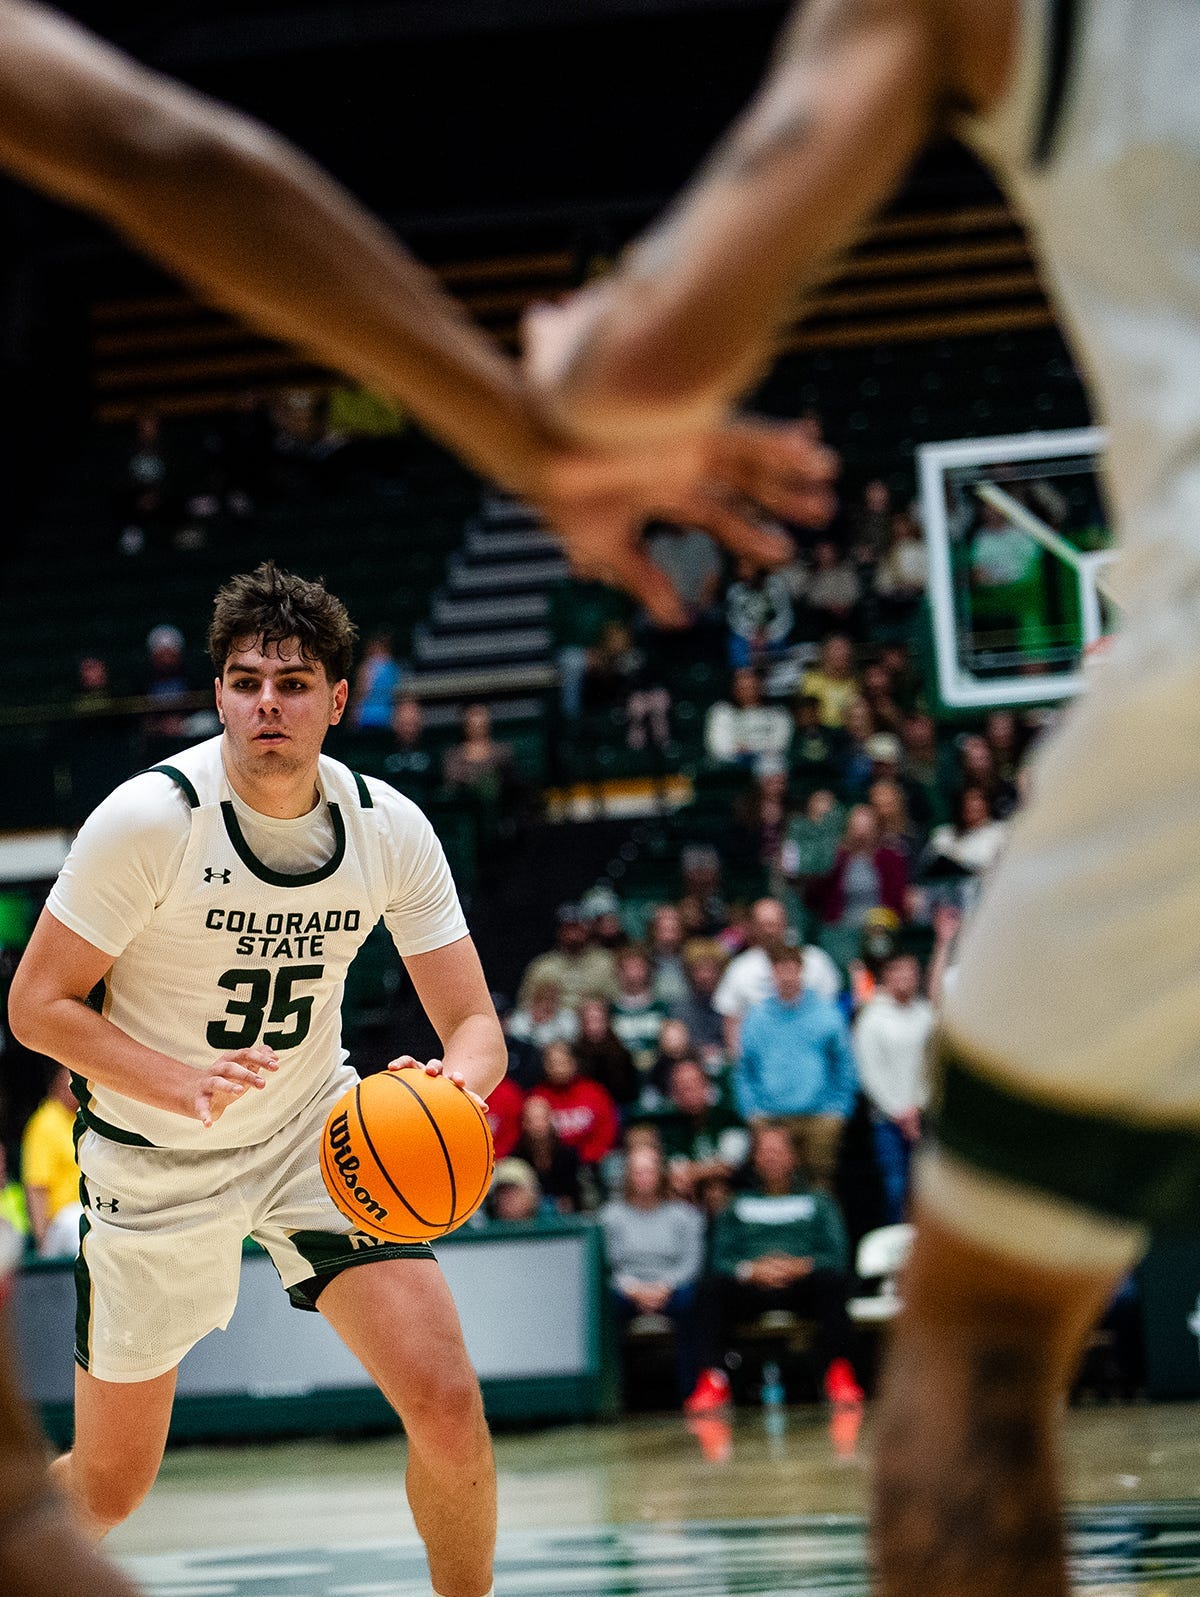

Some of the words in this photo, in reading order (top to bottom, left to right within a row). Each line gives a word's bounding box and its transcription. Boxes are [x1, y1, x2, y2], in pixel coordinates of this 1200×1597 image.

[205, 909, 361, 935] COLORADO
[236, 935, 325, 959] STATE
[206, 964, 325, 1051] 35
[329, 1110, 388, 1222] Wilson
